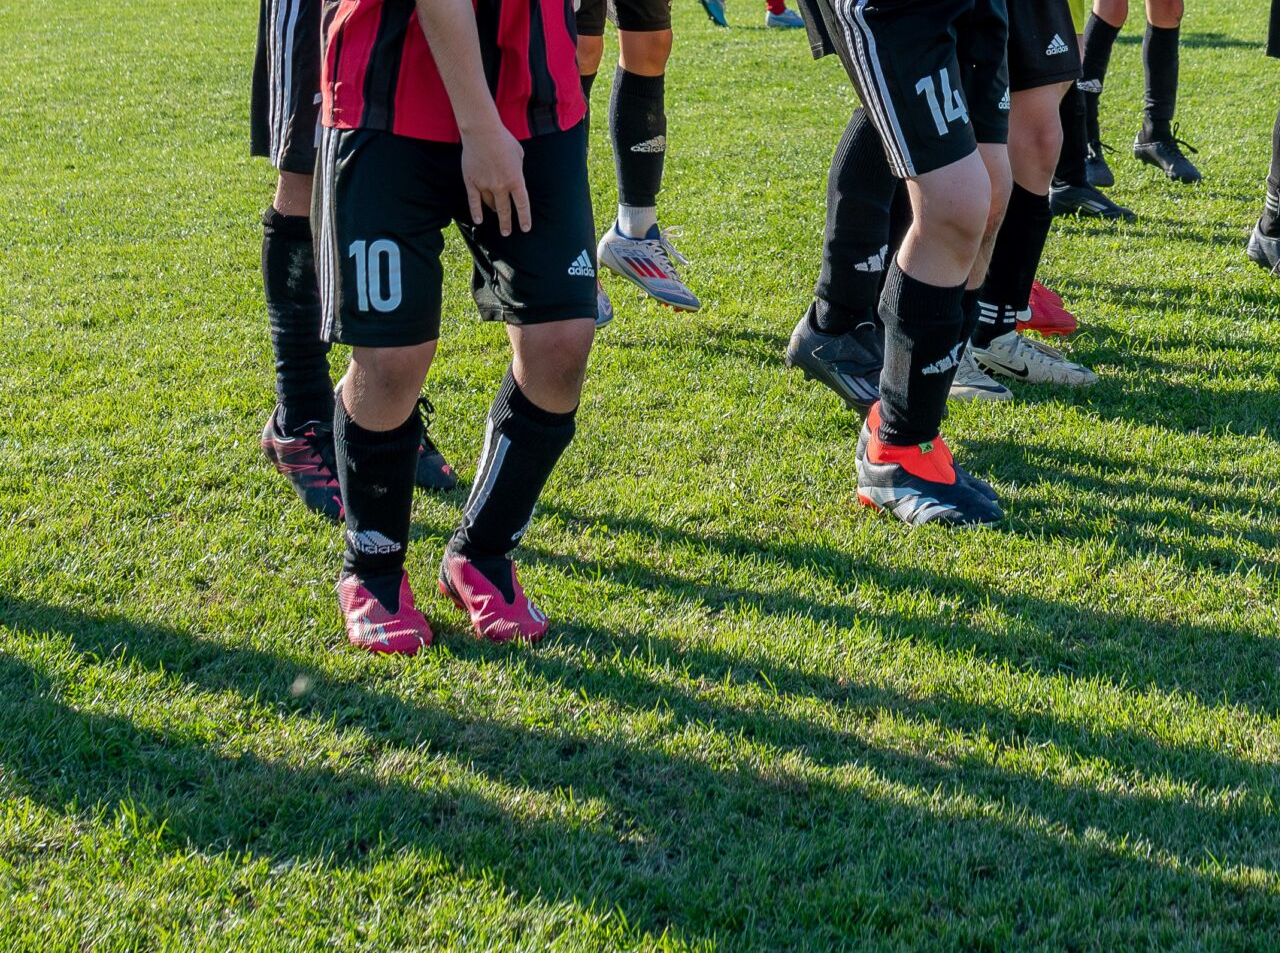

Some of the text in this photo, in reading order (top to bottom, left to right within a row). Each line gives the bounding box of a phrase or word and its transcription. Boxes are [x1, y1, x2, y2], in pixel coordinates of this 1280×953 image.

[1045, 45, 1069, 56] adidas
[915, 67, 969, 136] 14
[347, 239, 401, 312] 10
[567, 265, 595, 278] adidas
